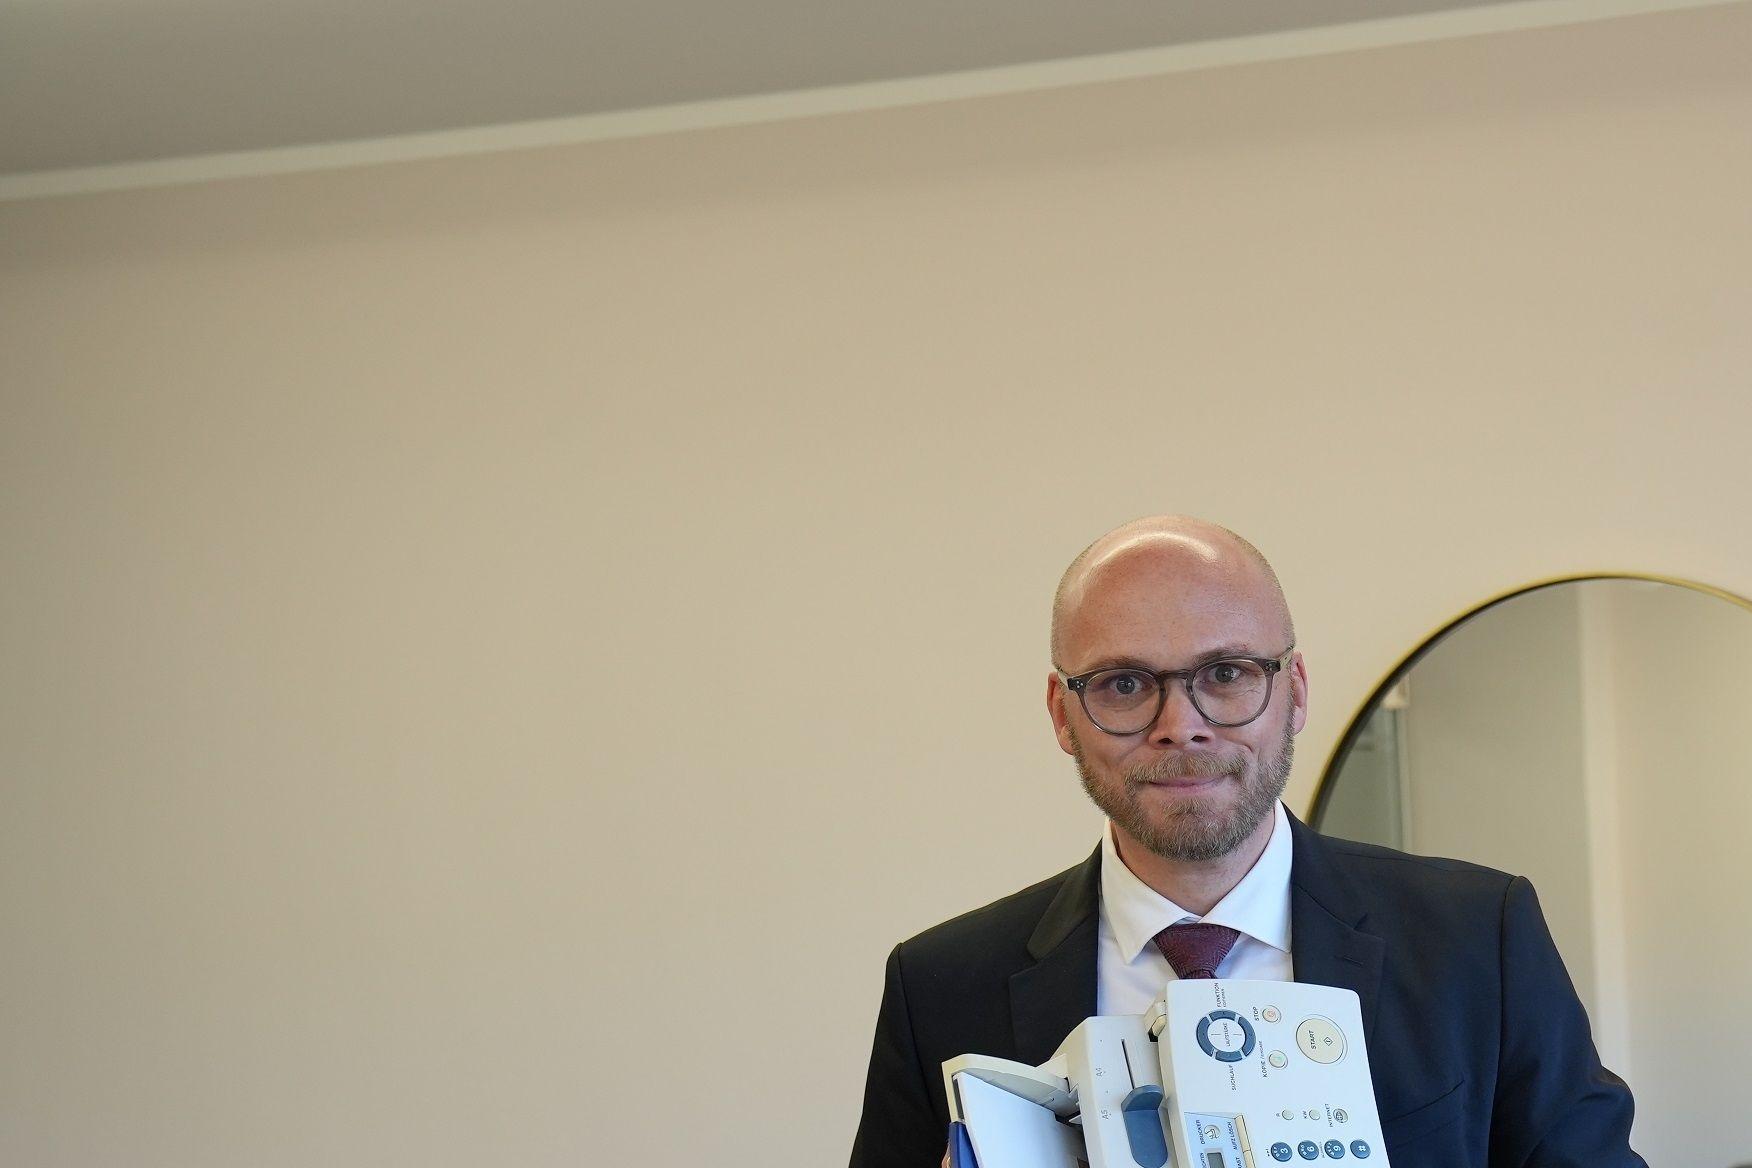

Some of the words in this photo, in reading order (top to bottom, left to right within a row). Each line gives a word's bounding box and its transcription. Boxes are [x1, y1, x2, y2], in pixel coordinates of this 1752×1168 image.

[1214, 982, 1222, 1008] FUNKTION
[1308, 1030, 1316, 1049] START
[1325, 1103, 1333, 1128] INTERNET
[1196, 1119, 1206, 1145] DRUCKER
